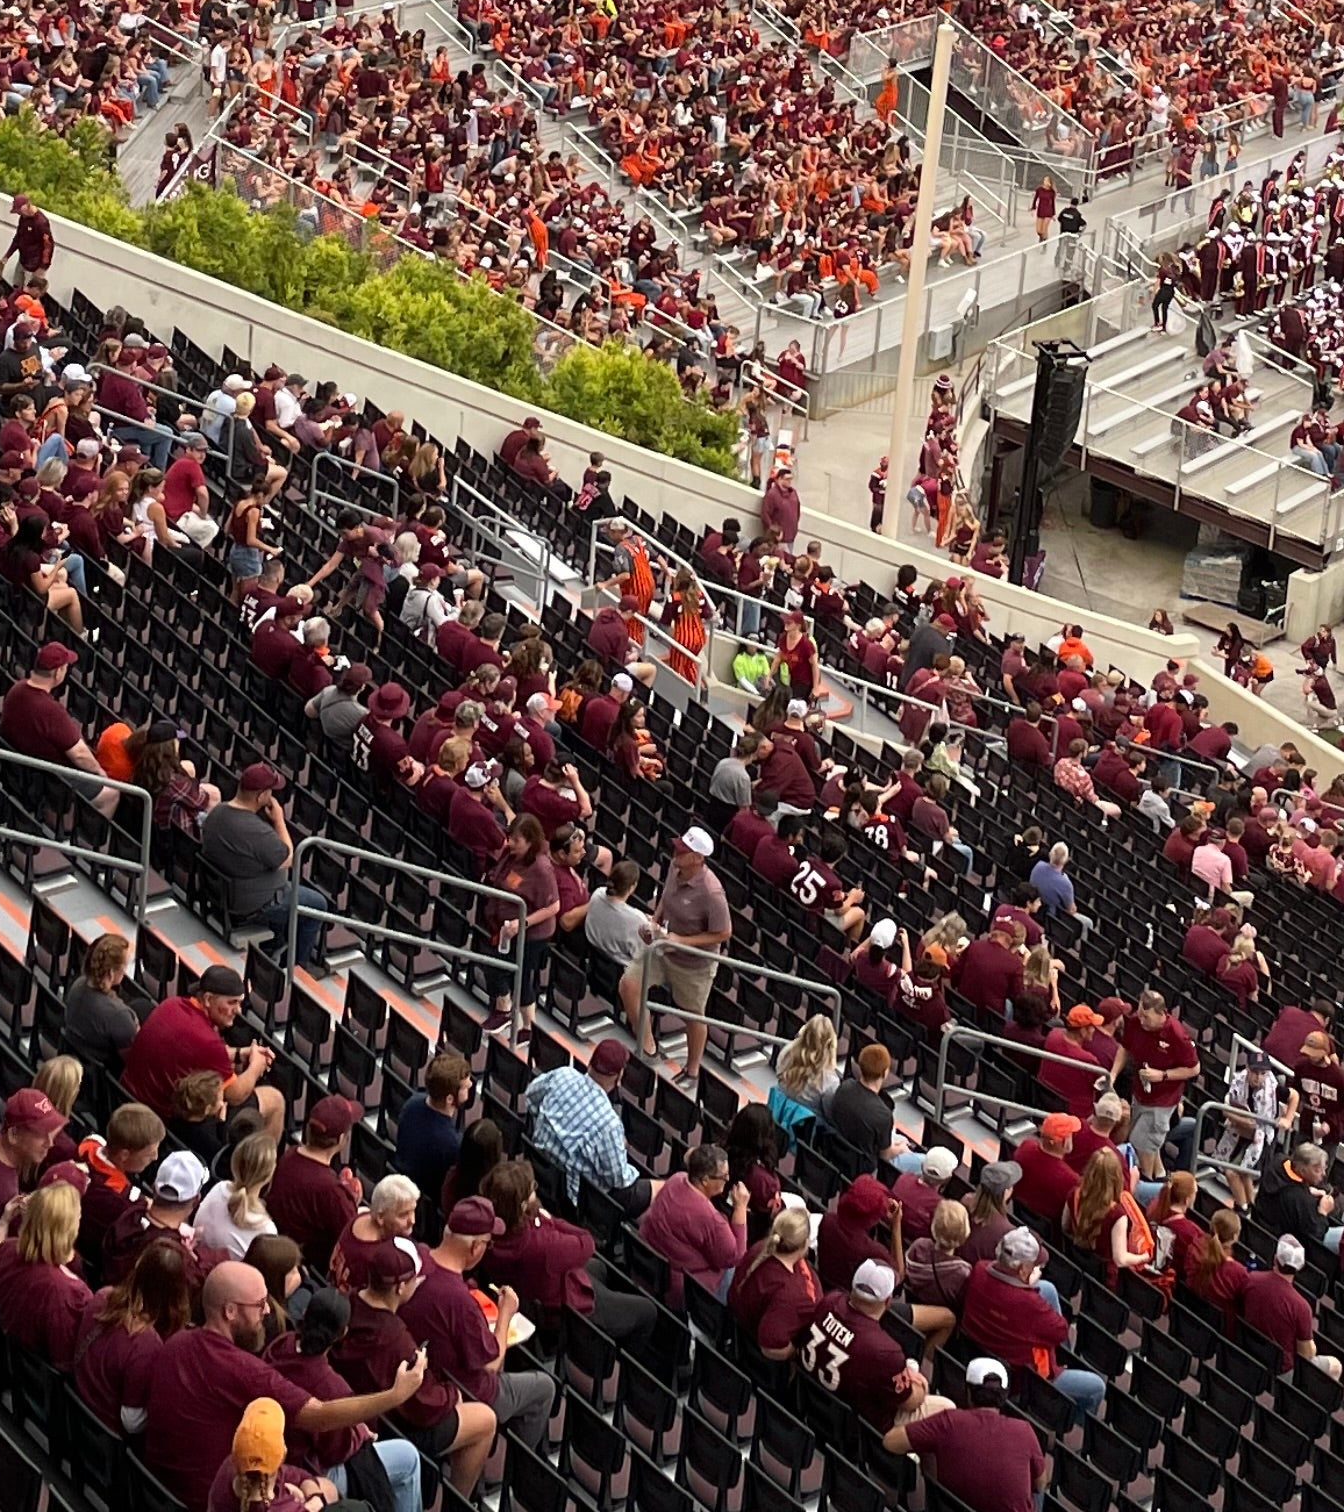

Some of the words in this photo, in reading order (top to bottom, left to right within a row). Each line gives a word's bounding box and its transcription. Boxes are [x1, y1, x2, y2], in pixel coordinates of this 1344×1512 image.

[790, 860, 826, 905] 25
[821, 1311, 855, 1349] TUTEN
[801, 1322, 850, 1393] 33
